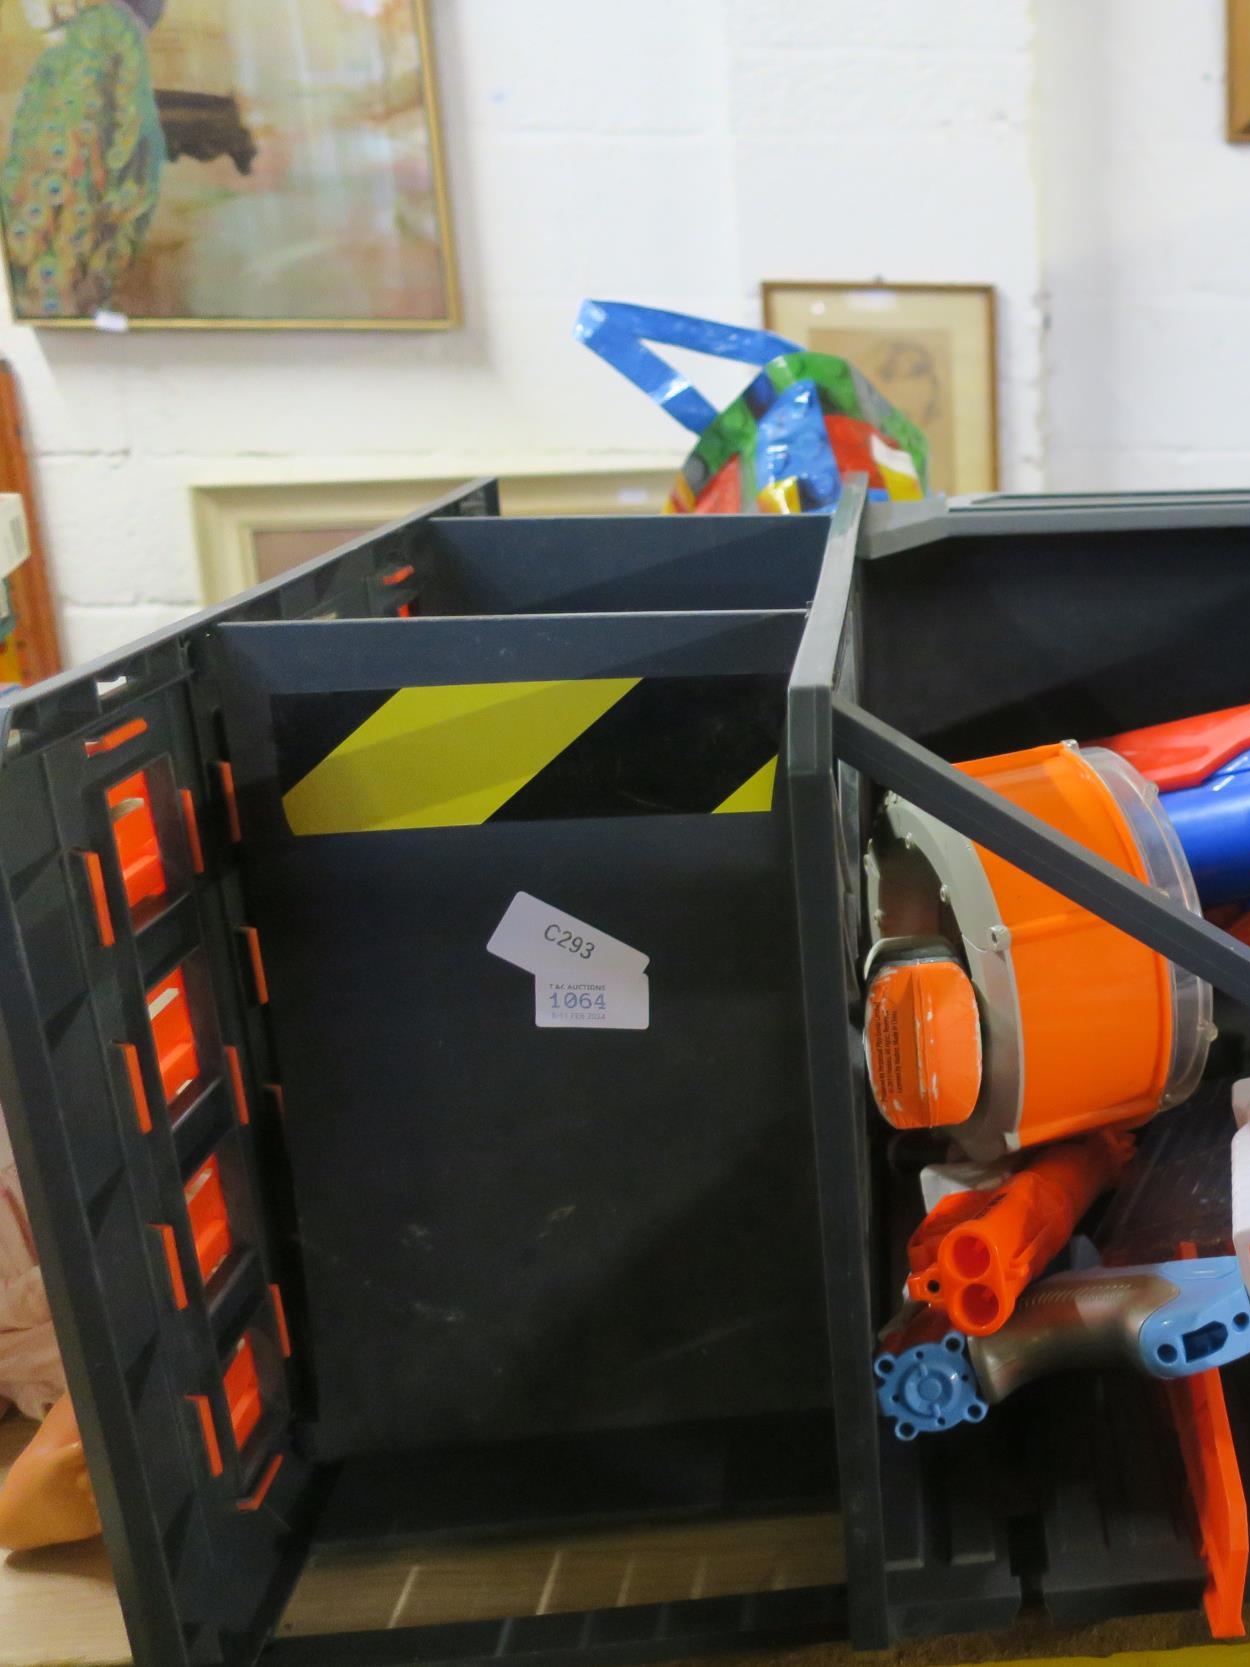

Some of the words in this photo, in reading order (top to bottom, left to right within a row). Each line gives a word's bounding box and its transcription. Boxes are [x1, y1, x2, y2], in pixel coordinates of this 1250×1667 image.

[544, 924, 595, 959] C293
[567, 983, 606, 991] AUCTIONS
[549, 991, 607, 1011] 1064
